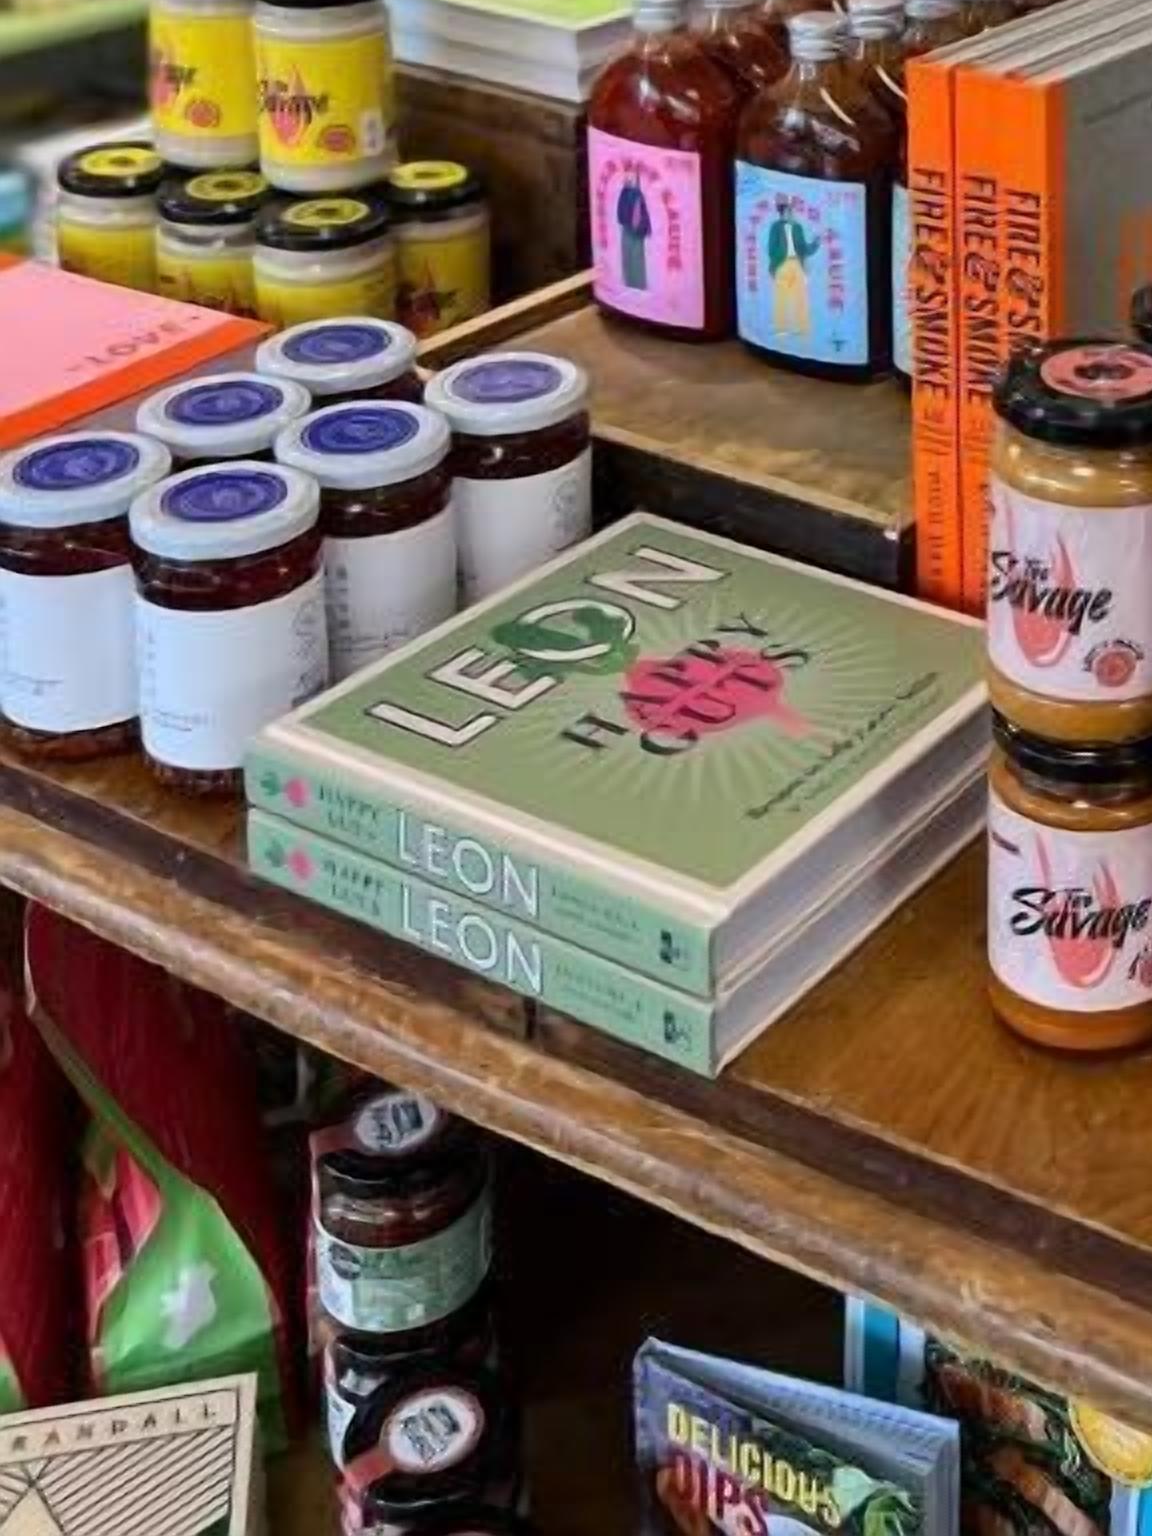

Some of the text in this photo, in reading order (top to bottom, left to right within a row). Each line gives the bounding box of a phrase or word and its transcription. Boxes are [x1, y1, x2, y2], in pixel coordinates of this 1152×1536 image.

[911, 166, 947, 241] FIRE
[961, 174, 999, 251] FIRE
[1003, 189, 1042, 265] FIRE
[913, 284, 951, 410] SMOKE
[990, 550, 1113, 636] Savage
[366, 544, 733, 750] LEON
[398, 808, 540, 919] LEON
[401, 882, 543, 997] LEON
[1009, 886, 1152, 949] Savage
[666, 1402, 842, 1529] DELICIOUS
